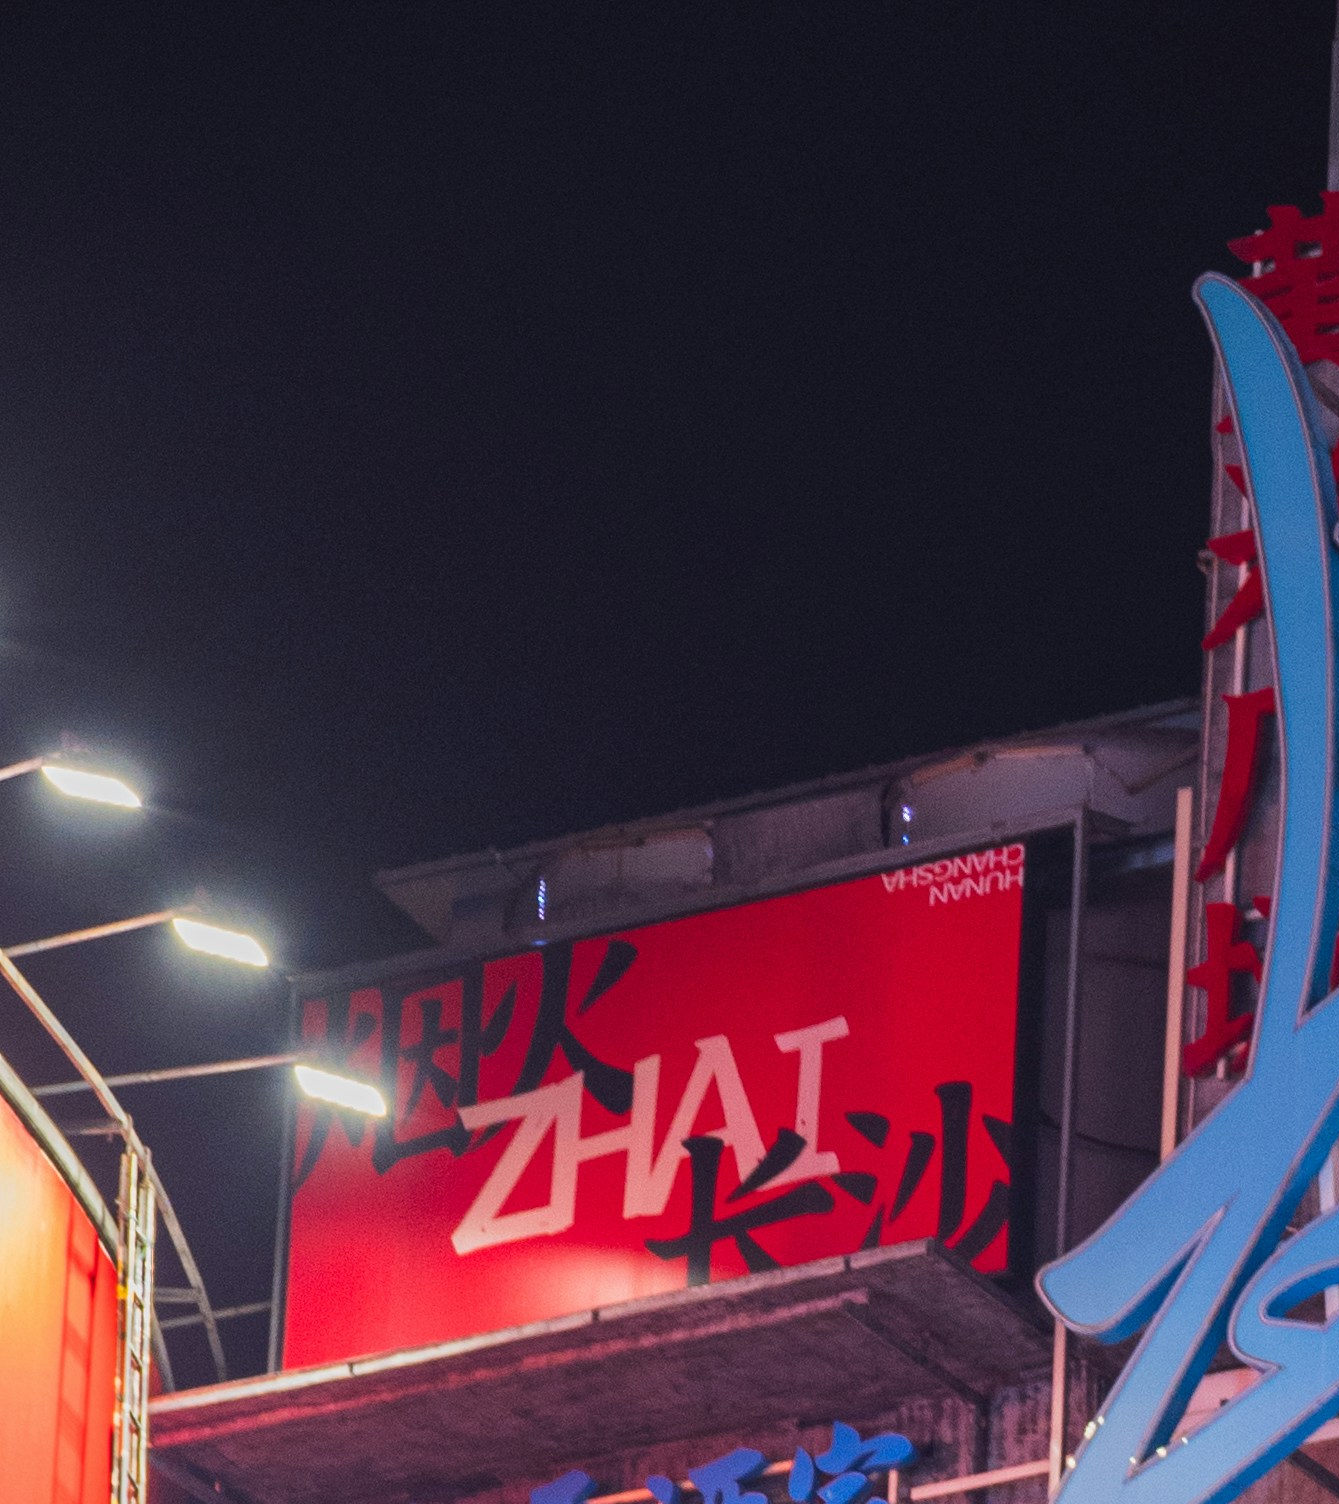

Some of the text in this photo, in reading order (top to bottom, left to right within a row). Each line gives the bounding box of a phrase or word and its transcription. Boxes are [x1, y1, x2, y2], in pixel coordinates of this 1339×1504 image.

[882, 844, 1024, 893] CHANGSHA
[929, 868, 1023, 907] HUNAN
[451, 1017, 848, 1256] ZHAI
